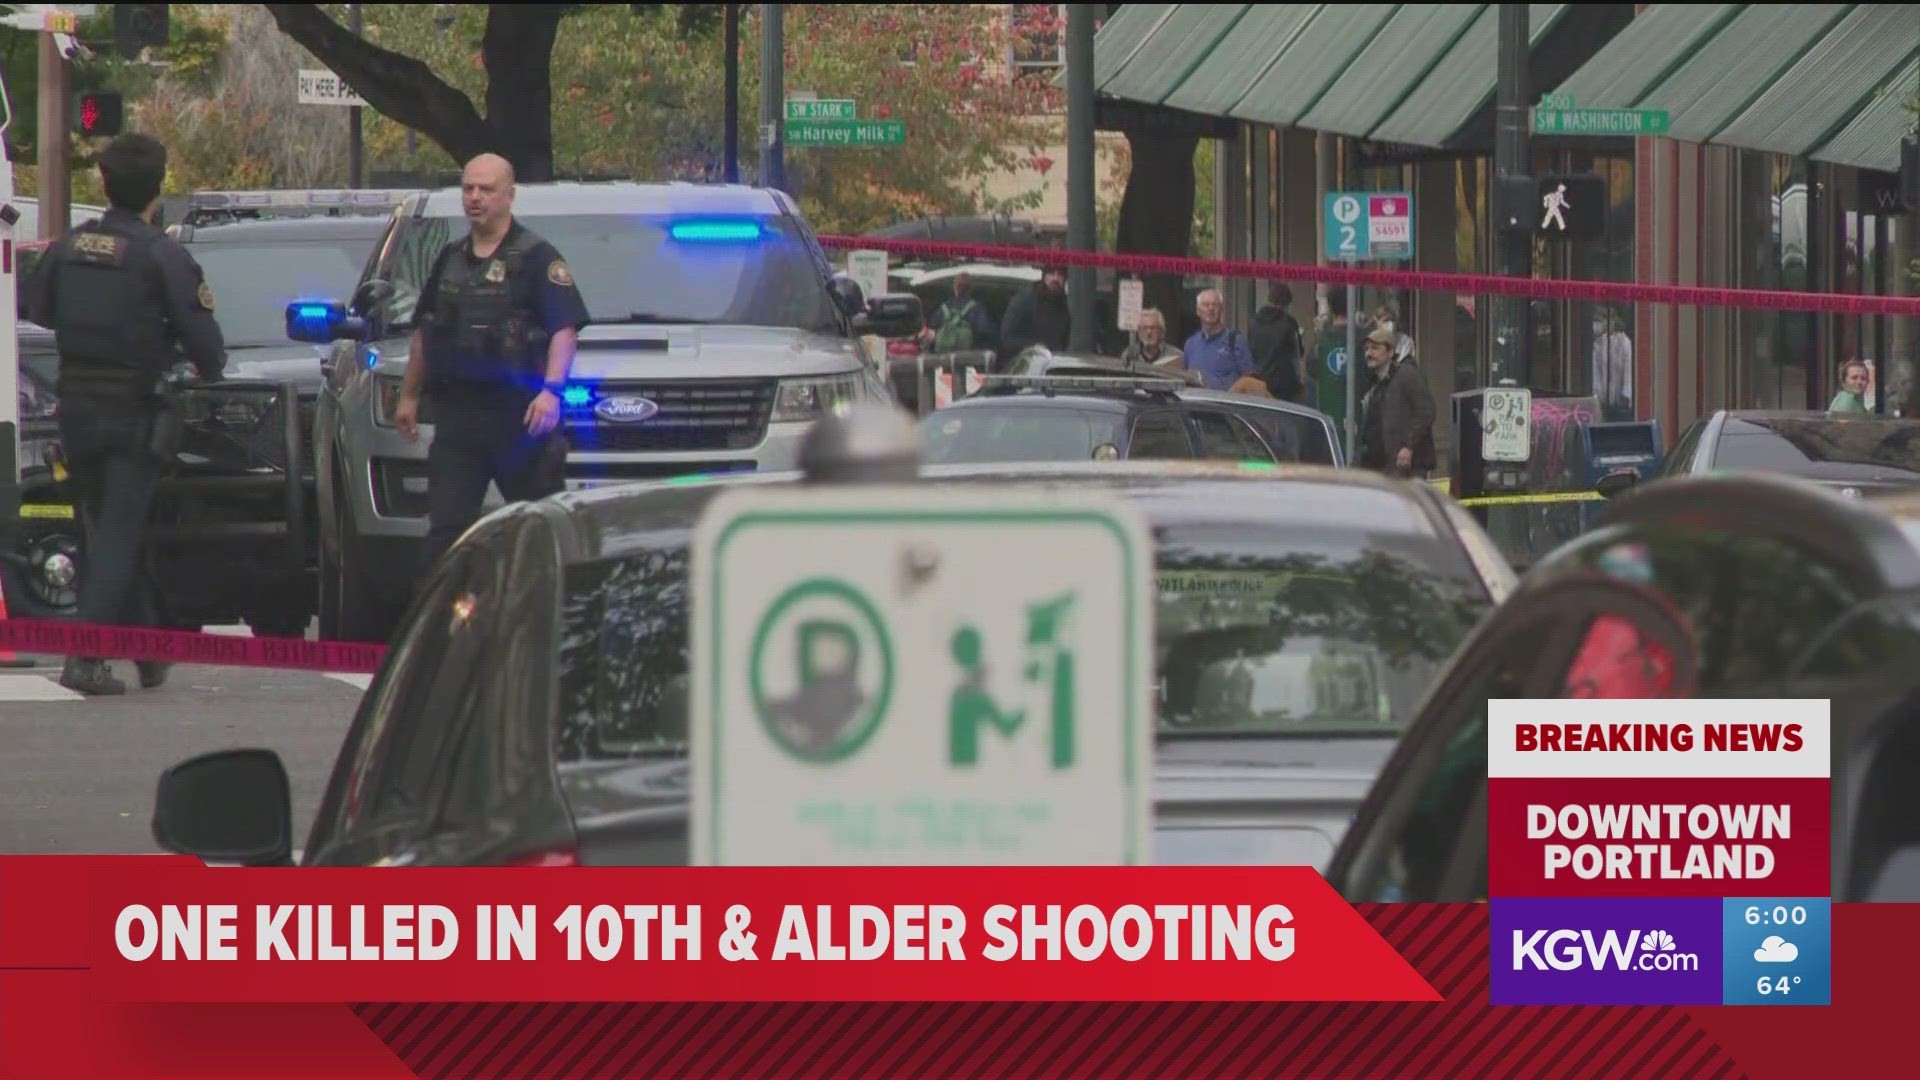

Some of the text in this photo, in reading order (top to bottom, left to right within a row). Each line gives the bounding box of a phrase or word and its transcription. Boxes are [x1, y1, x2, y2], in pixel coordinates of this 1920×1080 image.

[301, 78, 313, 96] PAY
[315, 79, 335, 97] HERE
[792, 103, 807, 117] SW
[811, 102, 842, 117] STARK
[1537, 111, 1556, 129] SW
[1563, 111, 1642, 130] WASHINGTON
[803, 126, 851, 144] Harvey
[857, 125, 885, 141] Milk
[1341, 201, 1354, 219] P
[1340, 226, 1357, 250] 2
[608, 400, 644, 415] Ford
